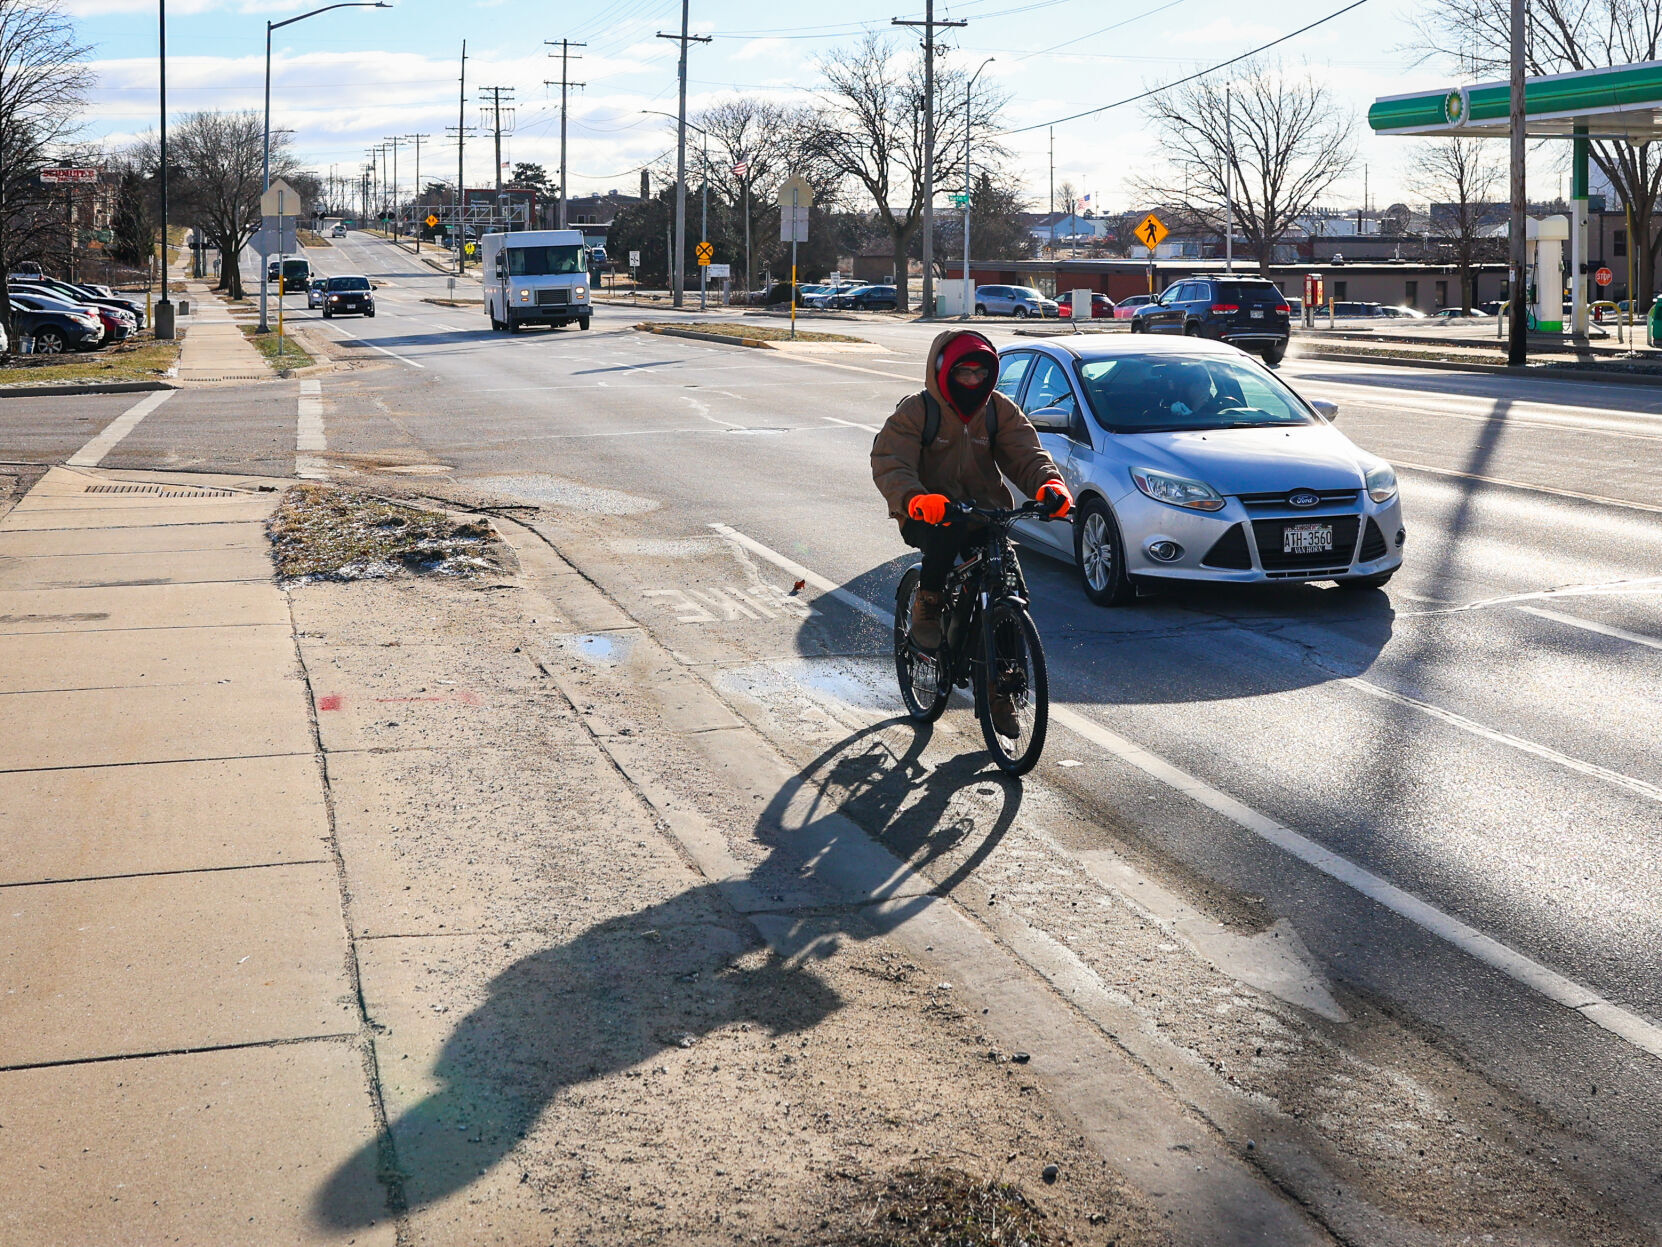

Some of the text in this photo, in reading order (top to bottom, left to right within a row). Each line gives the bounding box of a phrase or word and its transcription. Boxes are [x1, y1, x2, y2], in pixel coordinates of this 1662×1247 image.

[1296, 496, 1313, 504] Ford
[1284, 531, 1332, 547] ATH-3560
[1295, 545, 1323, 554] VAN HORN
